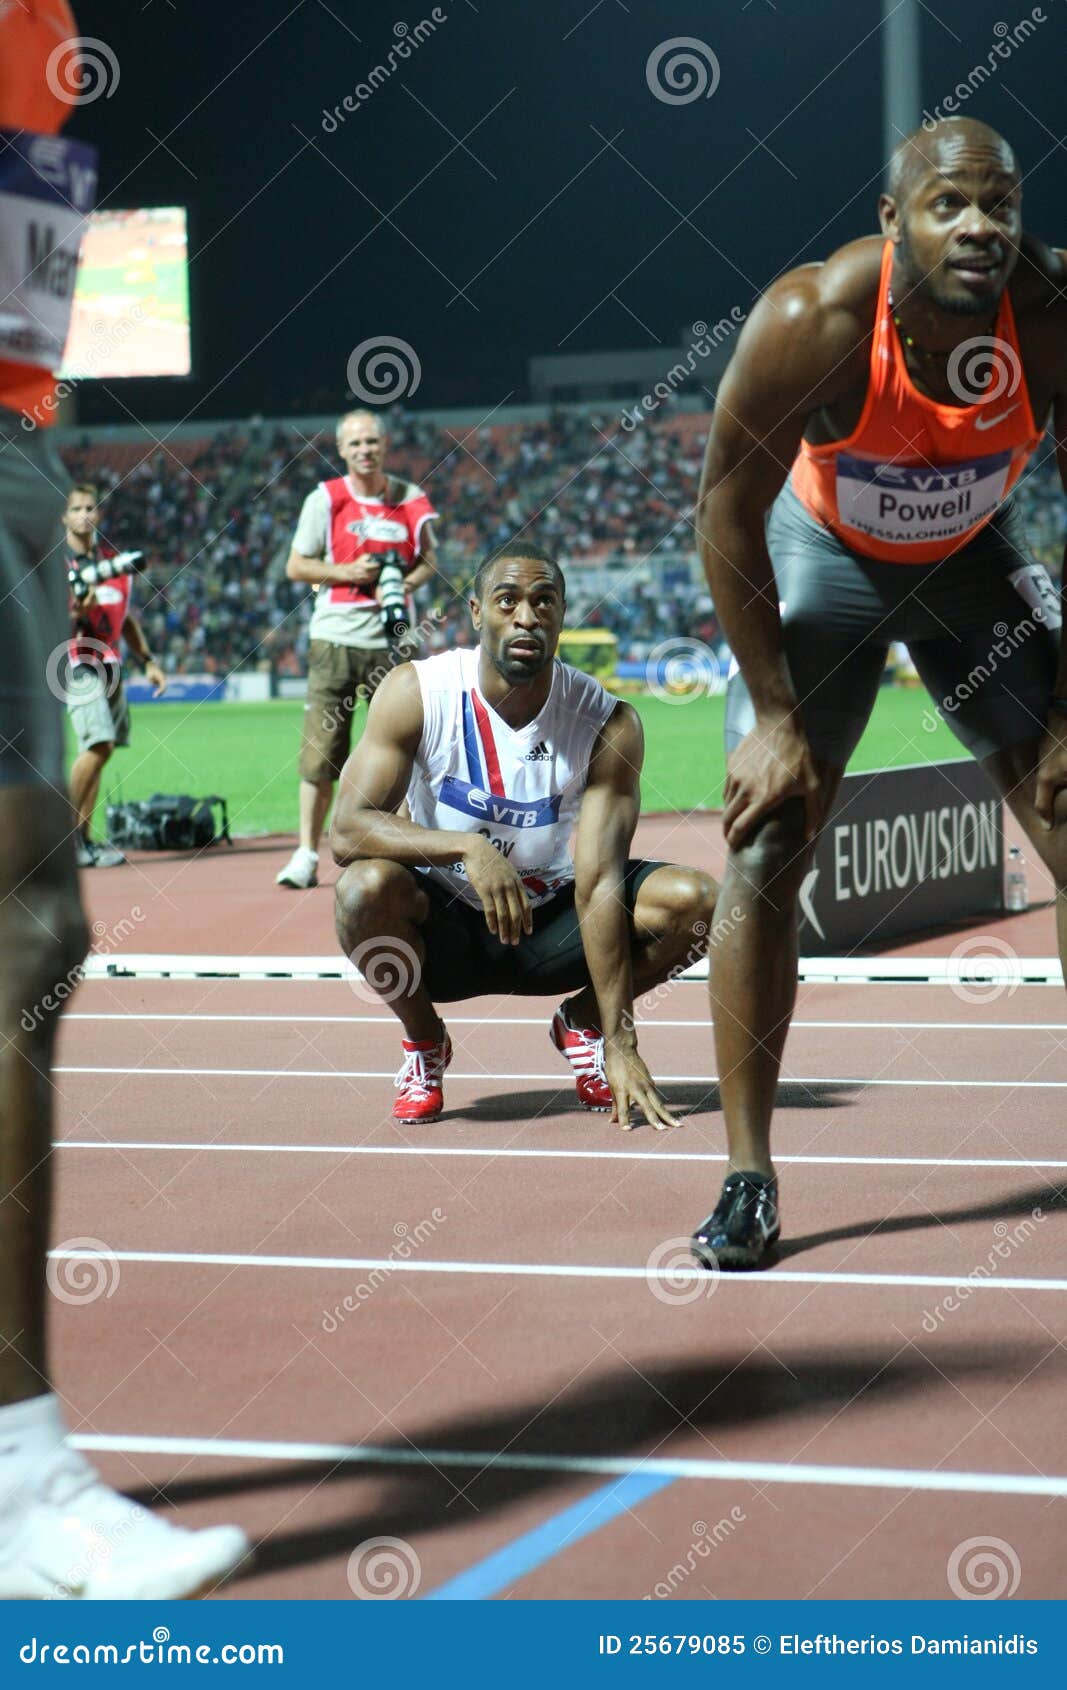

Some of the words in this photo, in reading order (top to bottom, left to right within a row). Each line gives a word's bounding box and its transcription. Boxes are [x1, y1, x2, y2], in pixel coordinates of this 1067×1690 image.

[911, 467, 977, 492] VTB
[878, 490, 972, 522] Powell
[524, 753, 554, 762] adidas
[492, 804, 538, 828] VTB
[833, 799, 997, 901] EUROVISION
